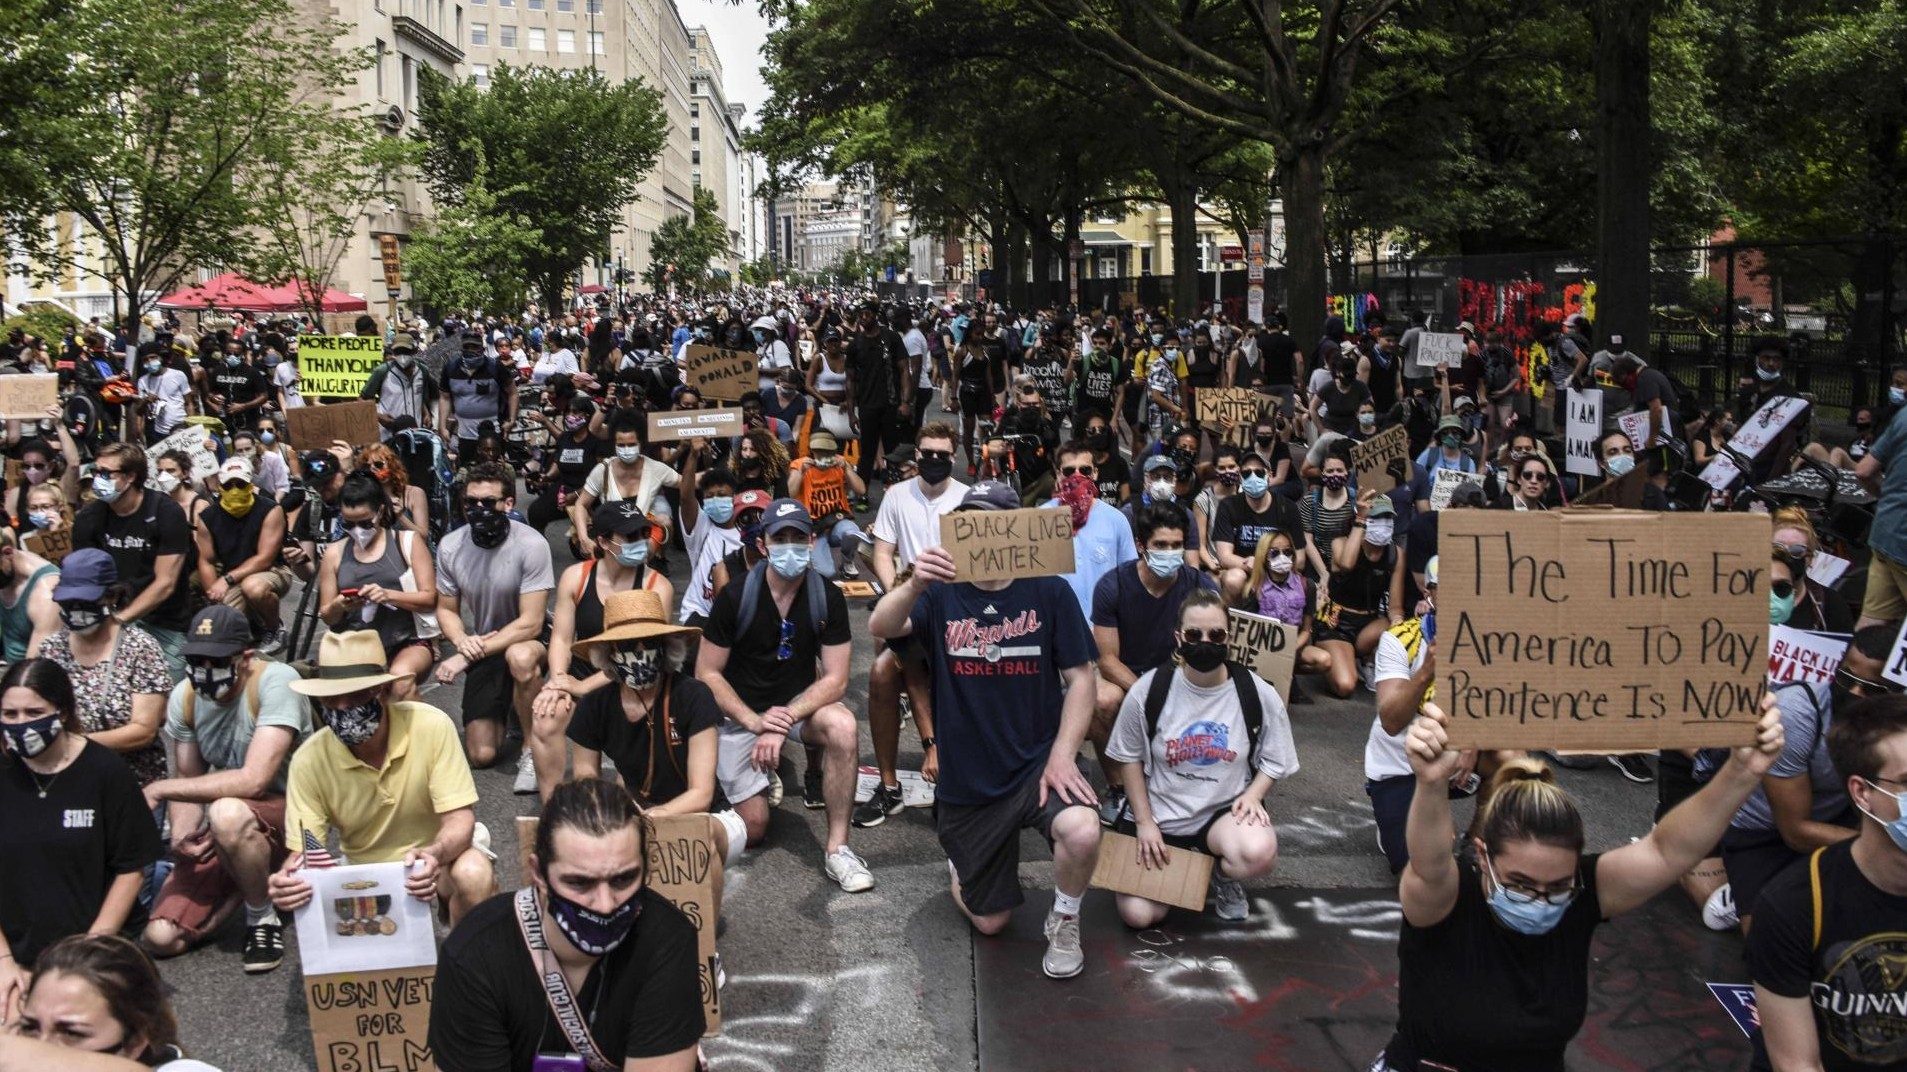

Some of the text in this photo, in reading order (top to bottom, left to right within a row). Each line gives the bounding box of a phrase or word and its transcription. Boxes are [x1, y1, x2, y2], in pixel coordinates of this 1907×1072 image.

[299, 336, 383, 352] MORE PEOPLE
[1425, 334, 1452, 350] FUCK
[304, 358, 343, 373] THAN
[688, 350, 737, 371] COWARD
[698, 360, 753, 385] DONALD
[1086, 379, 1112, 391] LIVES
[1201, 400, 1259, 422] MATTER
[1571, 400, 1596, 425] I AM
[1355, 443, 1405, 476] MATTER
[1567, 438, 1574, 457] A
[953, 514, 1072, 542] BLACK LIVES
[969, 545, 1046, 575] MATTER
[1447, 530, 1764, 602] The Time For
[945, 609, 1042, 657] Wizards
[1448, 610, 1614, 667] America
[1700, 616, 1759, 675] Pay
[1773, 638, 1821, 668] BLACK
[1447, 669, 1609, 725] Penitence
[1622, 683, 1666, 720] Is
[1166, 734, 1215, 758] PLANET
[1166, 746, 1238, 769] HOLLYWOOD
[63, 809, 96, 829] STAFF
[312, 982, 378, 1011] USN
[544, 972, 571, 1009] CLUB
[356, 1012, 405, 1037] FOR
